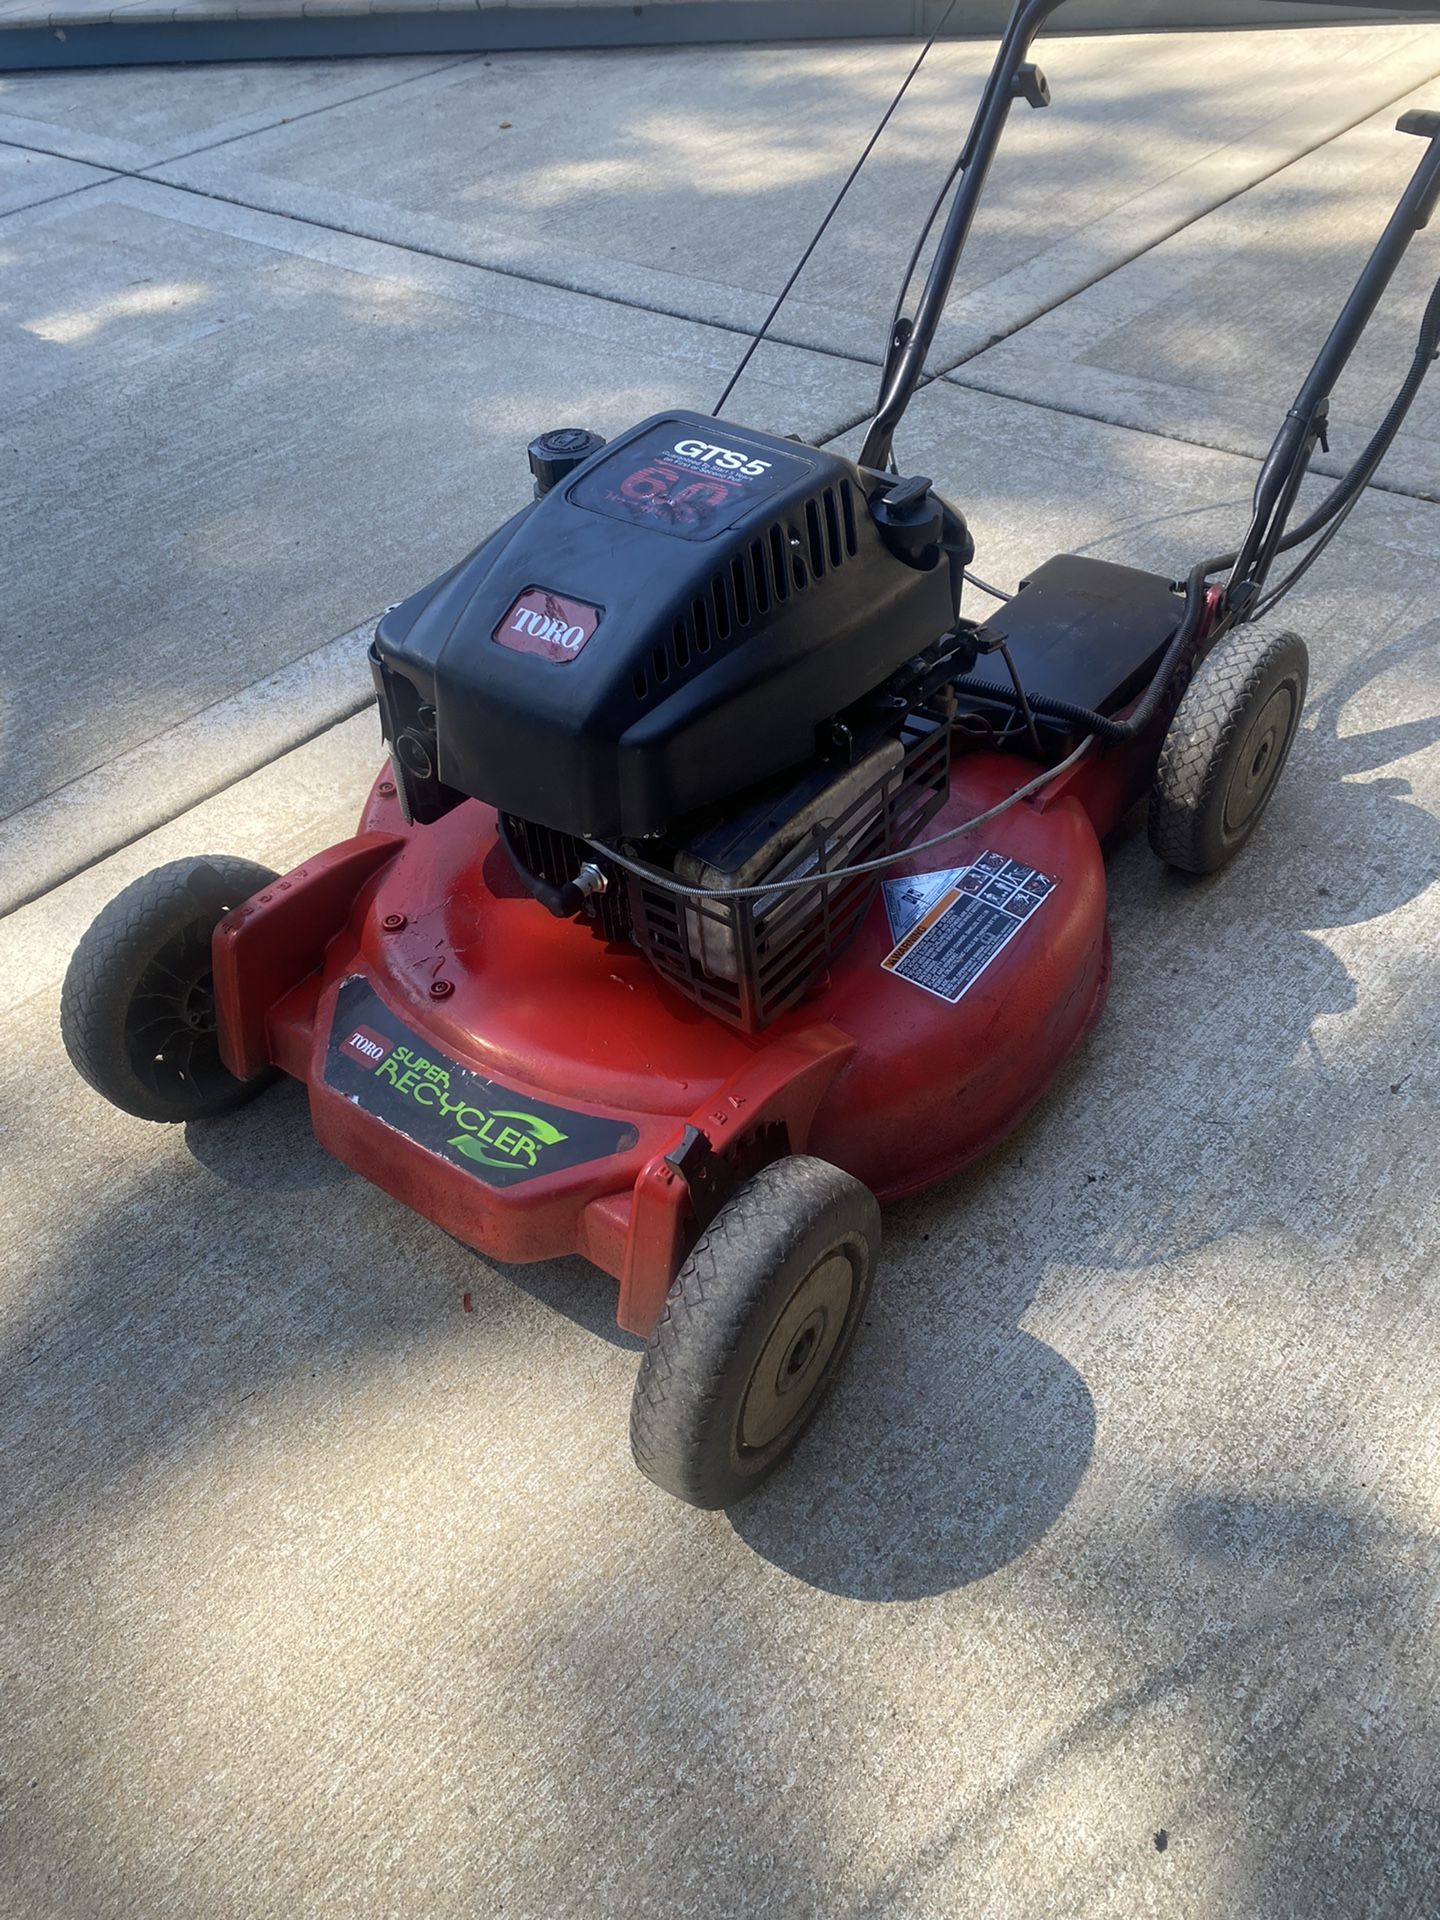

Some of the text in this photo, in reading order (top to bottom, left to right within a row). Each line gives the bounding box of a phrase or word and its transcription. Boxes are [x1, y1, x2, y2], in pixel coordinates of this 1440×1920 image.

[674, 440, 772, 475] GTS5
[511, 607, 584, 651] TORO
[889, 924, 928, 961] WARNING
[349, 1032, 383, 1060] TORO
[392, 1046, 450, 1089] SUPER
[374, 1058, 537, 1167] RECYCLER
